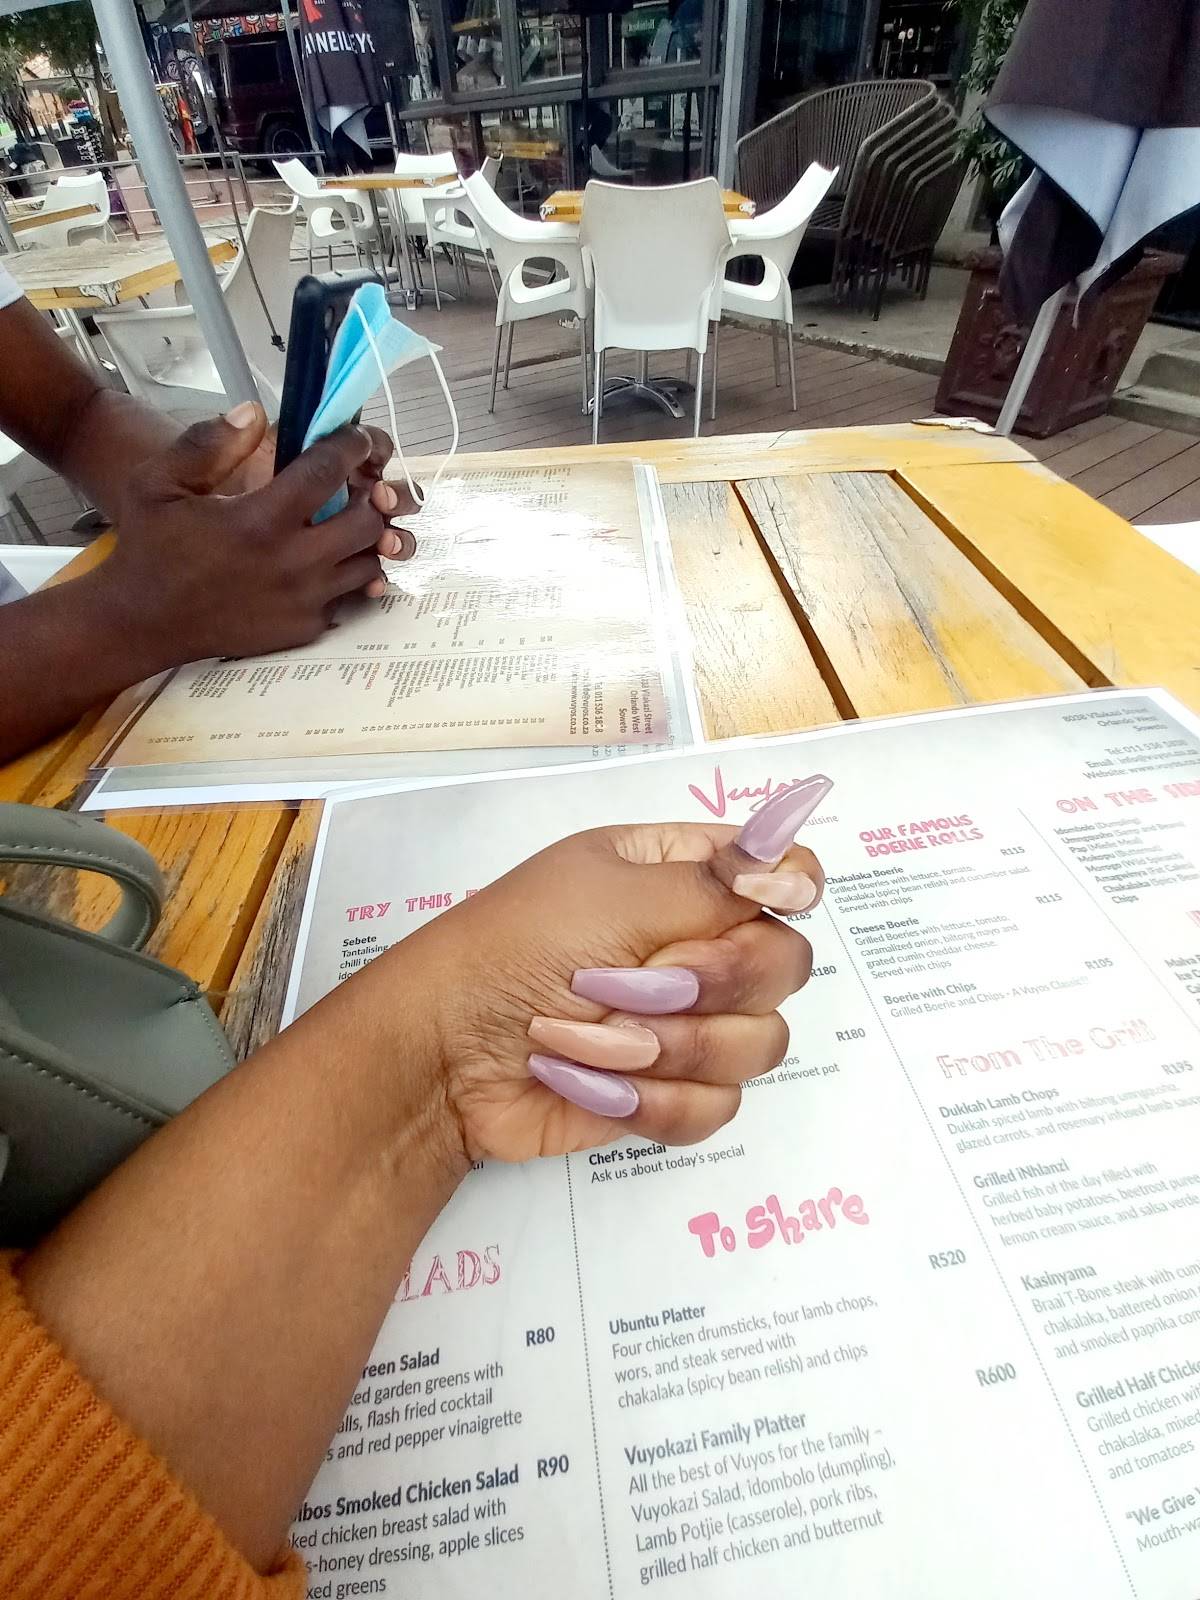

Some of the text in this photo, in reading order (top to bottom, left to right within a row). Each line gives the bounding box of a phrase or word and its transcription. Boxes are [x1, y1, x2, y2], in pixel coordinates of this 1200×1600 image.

[619, 708, 628, 734] Soweto
[1056, 796, 1098, 814] ON
[859, 814, 974, 843] OUR FAMOUS
[865, 827, 984, 858] BOERIE ROLLS
[1000, 846, 1025, 857] R115
[825, 867, 903, 884] Chakalaka Boerie
[829, 876, 910, 894] Grilled Boeries with
[345, 902, 392, 922] TRY
[405, 892, 452, 912] THIS
[838, 897, 913, 913] Served with chips
[1035, 893, 1063, 905] R115
[342, 936, 377, 947] Sebete
[849, 918, 919, 935] Cheese Boerie
[340, 957, 361, 969] chilli
[810, 965, 837, 978] R180
[1084, 957, 1114, 970] R105
[884, 983, 976, 1004] Boerie with Chips
[836, 1027, 866, 1042] R180
[936, 1017, 1157, 1080] From The Grill
[778, 1067, 820, 1081] drievoet
[822, 1063, 840, 1076] pot
[939, 1089, 1059, 1118] Dukkah Lamb Chops
[589, 1145, 667, 1165] Chef's Special
[591, 1144, 744, 1183] Ask us about today's special
[688, 1187, 870, 1258] To Share
[400, 1243, 501, 1301] LADS
[928, 1249, 967, 1270] R520
[1032, 1269, 1175, 1313] Braai T-Bone steak with
[609, 1307, 705, 1334] Ubuntu Platter
[612, 1296, 877, 1359] Four chicken drumsticks, four lamb chops,
[1044, 1295, 1161, 1335] chakalaka, battered
[525, 1326, 556, 1347] R80
[362, 1349, 439, 1379] reen Salad
[615, 1334, 796, 1383] wors, and steak served with
[349, 1362, 503, 1405] ed garden greens with
[618, 1345, 868, 1408] chakalaka (spicy bean relish) and chips
[974, 1362, 1017, 1388] R600
[1077, 1361, 1200, 1407] Grilled Half Chicke
[368, 1407, 399, 1427] flash
[405, 1399, 436, 1420] fried
[441, 1388, 492, 1413] cocktail
[338, 1411, 521, 1459] and red pepper vinaigrette
[625, 1415, 805, 1465] Vuyokazi Family Platter
[536, 1454, 570, 1479] R90
[629, 1427, 869, 1494] All the best of Vuyos for the family
[1109, 1441, 1194, 1479] and tomatoes
[291, 1465, 518, 1522] ibos Smoked Chicken Salad
[632, 1451, 895, 1522] Vuyokazi Salad, idombolo (dumpling),
[636, 1485, 877, 1552] Lamb Potjie (casserole), pork ribs,
[1162, 1495, 1195, 1514] Give
[287, 1499, 506, 1553] ked chicken breast salad with
[1137, 1520, 1200, 1551] Mouth-wa
[303, 1527, 524, 1580] s-honey dressing, apple slices
[640, 1510, 883, 1585] grilled half chicken and butternut
[306, 1579, 386, 1600] xed greens
